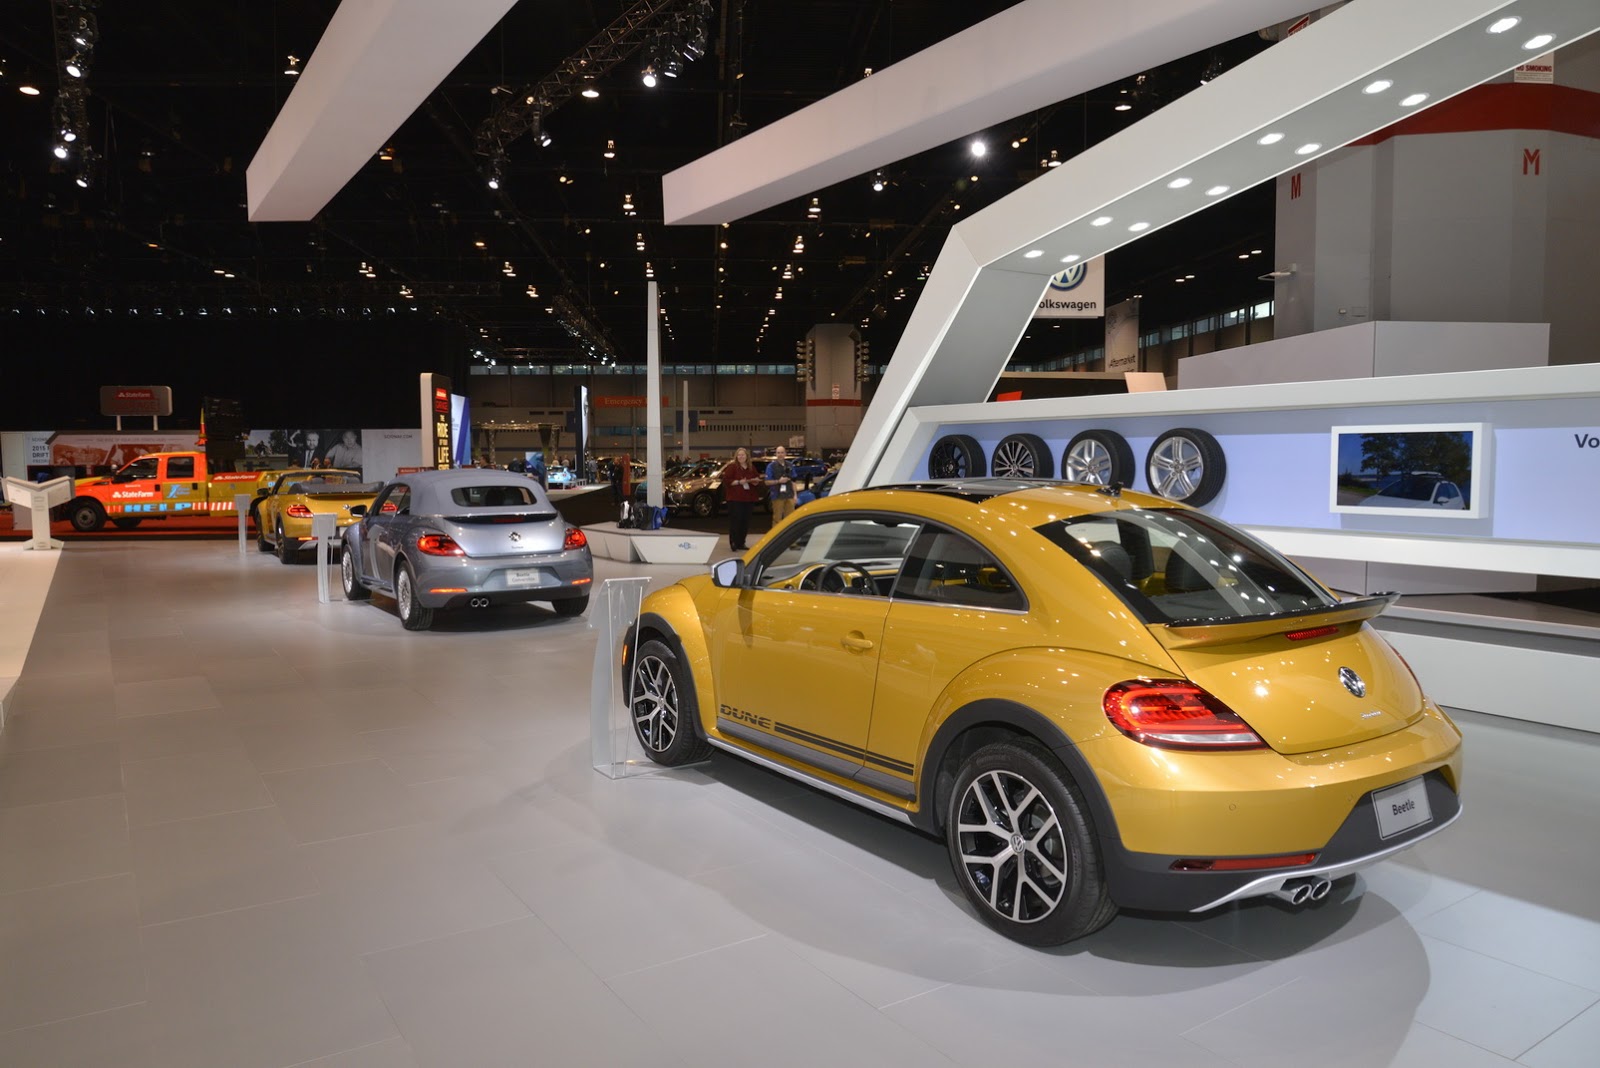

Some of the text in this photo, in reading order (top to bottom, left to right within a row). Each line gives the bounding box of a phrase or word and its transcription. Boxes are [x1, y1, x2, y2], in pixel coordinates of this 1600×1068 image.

[1525, 65, 1553, 73] SMOKING
[1523, 148, 1541, 176] M
[1291, 173, 1302, 200] M
[1039, 299, 1097, 311] olkswagen
[604, 397, 642, 406] Emergency
[1574, 433, 1600, 449] Vo
[438, 447, 449, 463] LIFE
[124, 502, 192, 513] HELP
[720, 703, 772, 730] DUNE
[1391, 799, 1416, 816] Beetle
